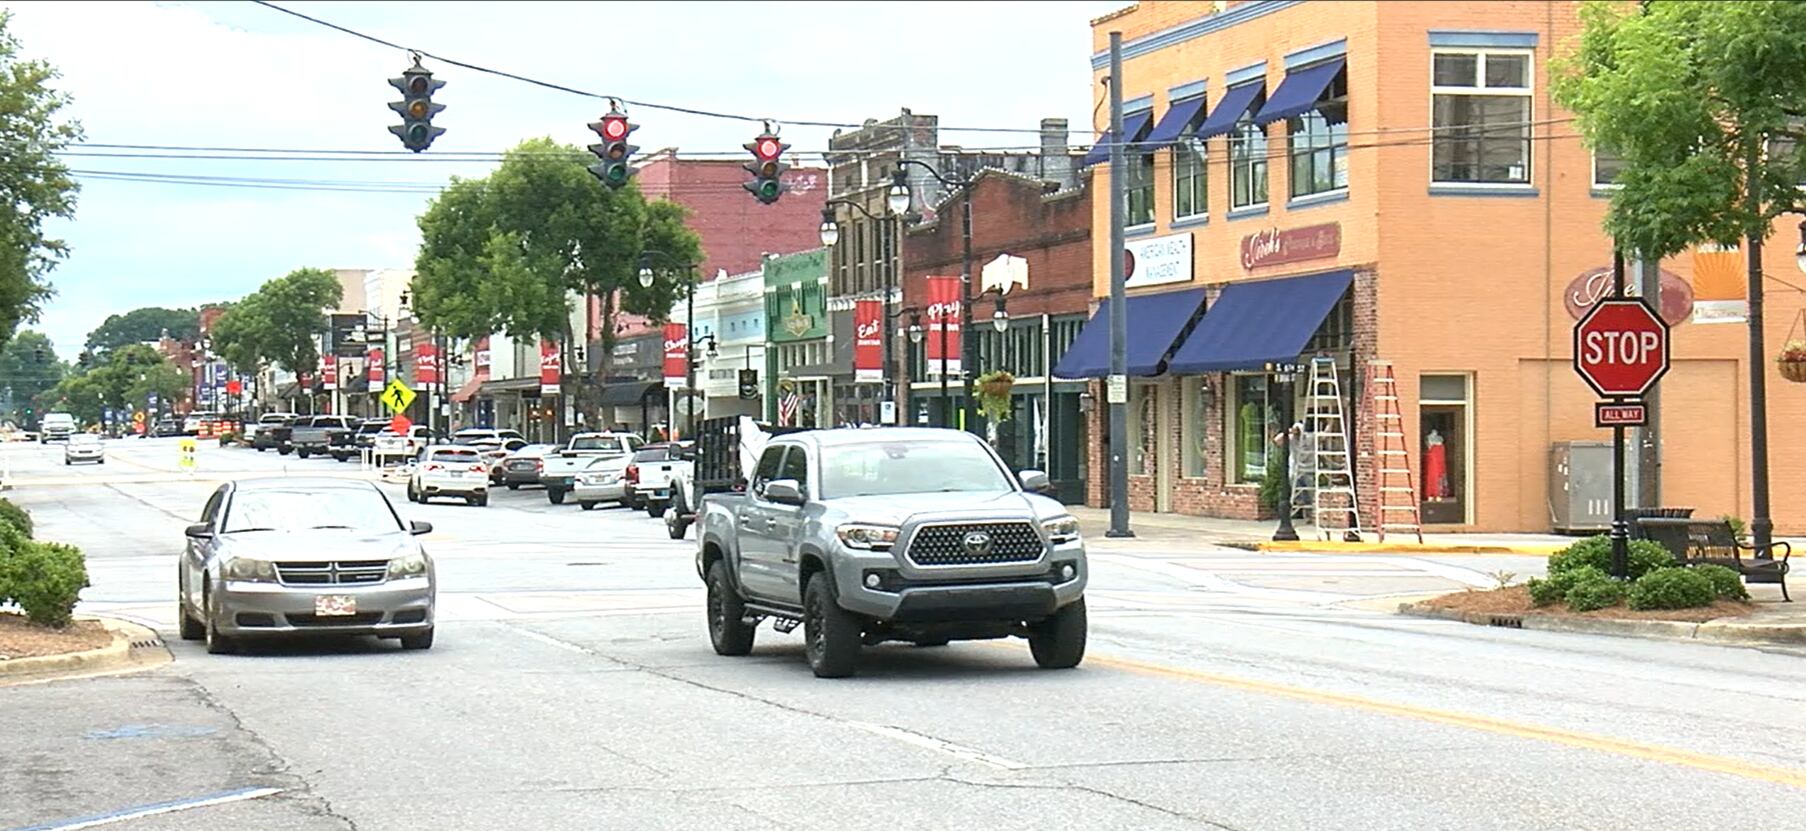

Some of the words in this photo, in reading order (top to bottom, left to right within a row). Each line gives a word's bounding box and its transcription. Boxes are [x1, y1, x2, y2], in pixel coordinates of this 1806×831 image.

[858, 319, 879, 338] Eat
[1585, 331, 1658, 365] STOP
[1604, 410, 1620, 419] ALL
[1622, 410, 1639, 419] WAY
